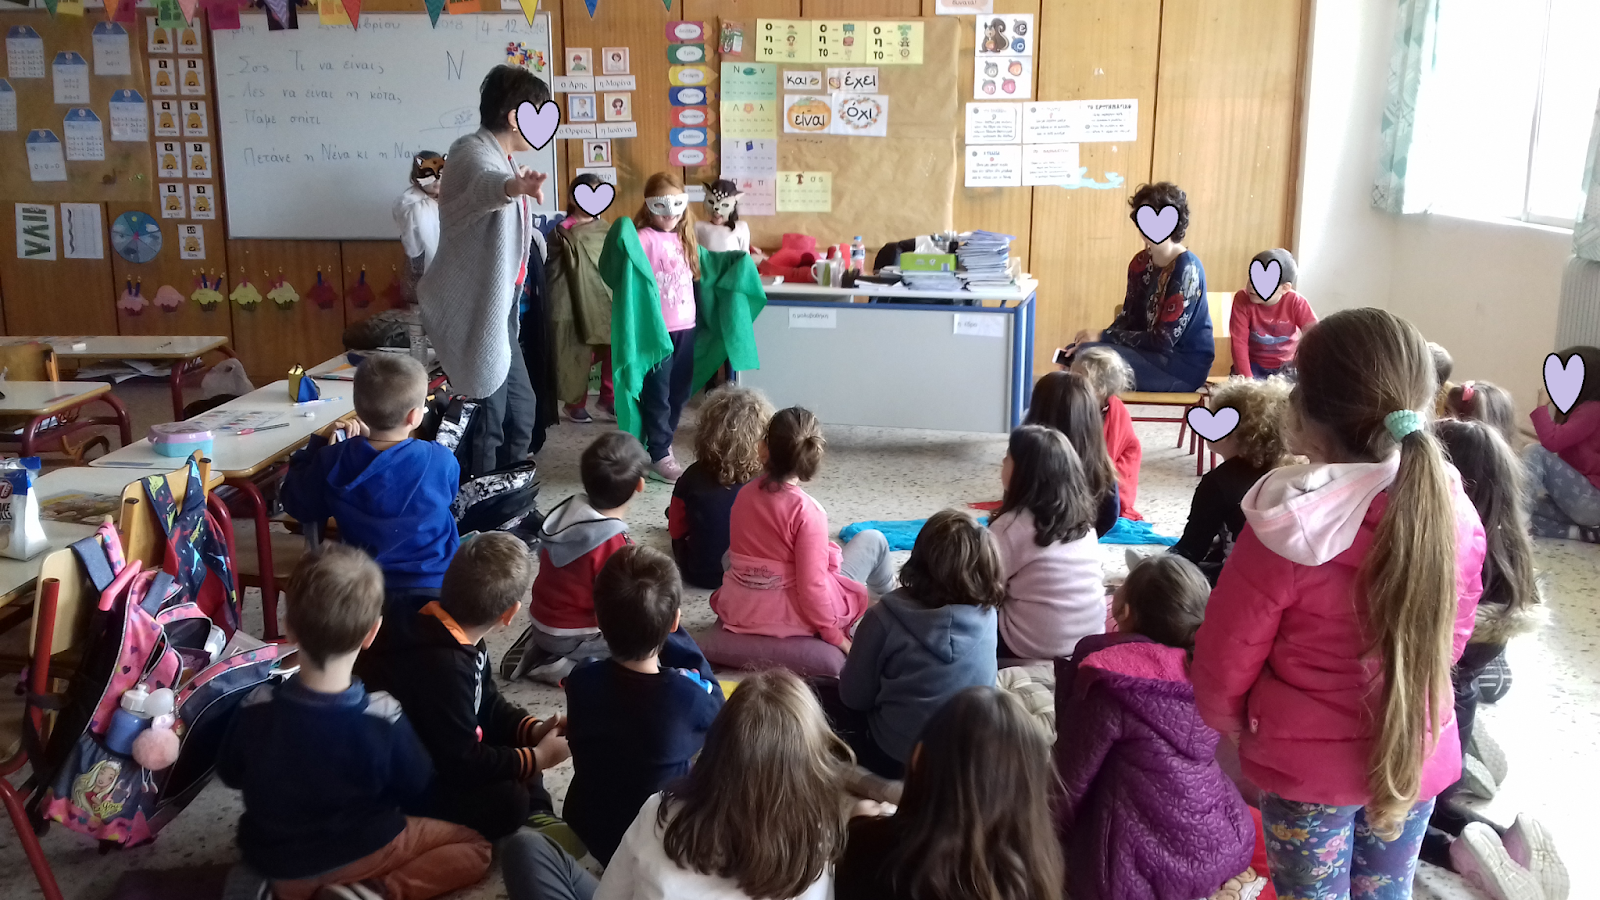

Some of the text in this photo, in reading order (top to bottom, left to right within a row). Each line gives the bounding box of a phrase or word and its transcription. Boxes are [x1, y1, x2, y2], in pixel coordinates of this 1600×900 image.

[787, 76, 806, 85] και
[844, 71, 876, 89] έχει
[795, 111, 825, 126] είναι
